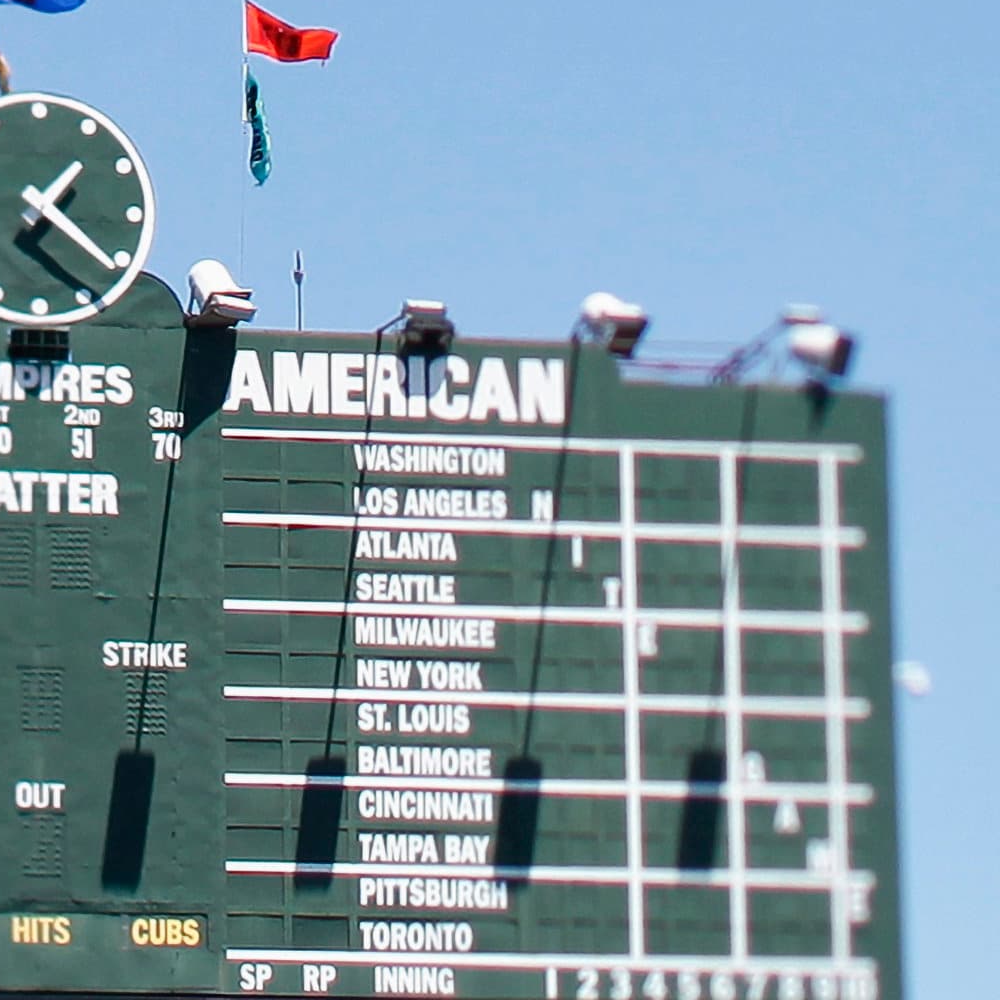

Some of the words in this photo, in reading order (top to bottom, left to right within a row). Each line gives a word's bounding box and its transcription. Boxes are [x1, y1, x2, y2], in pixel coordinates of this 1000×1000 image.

[223, 350, 565, 424] AMERICAN
[64, 402, 100, 425] 2ND
[148, 407, 185, 428] 3RD
[72, 429, 92, 458] 51
[152, 433, 180, 459] 70
[353, 443, 505, 476] WASHINGTON
[353, 486, 398, 516] LOS
[403, 488, 508, 519] ANGELES
[355, 530, 457, 561] ATLANTA
[355, 573, 455, 604] SEATTLE
[355, 617, 496, 648] MILWAUKEE
[103, 642, 186, 667] STRIKE
[356, 659, 412, 689] NEW
[416, 660, 483, 691] YORK
[358, 703, 391, 731] ST.
[399, 703, 469, 733] LOUIS
[357, 746, 492, 777] BALTIMORE
[16, 782, 65, 808] OUT
[358, 790, 494, 822] CINCINNATI
[358, 834, 434, 863] TAMPA
[444, 836, 490, 865] BAY
[359, 878, 508, 909] PITTSBURGH
[12, 917, 70, 944] HITS
[132, 919, 199, 946] CUBS
[358, 922, 473, 952] TORONTO
[239, 963, 273, 993] SP
[303, 965, 337, 994] RP
[374, 967, 455, 995] INNING
[577, 968, 599, 1000] 2
[610, 968, 632, 1000] 3
[643, 969, 667, 1000] 4
